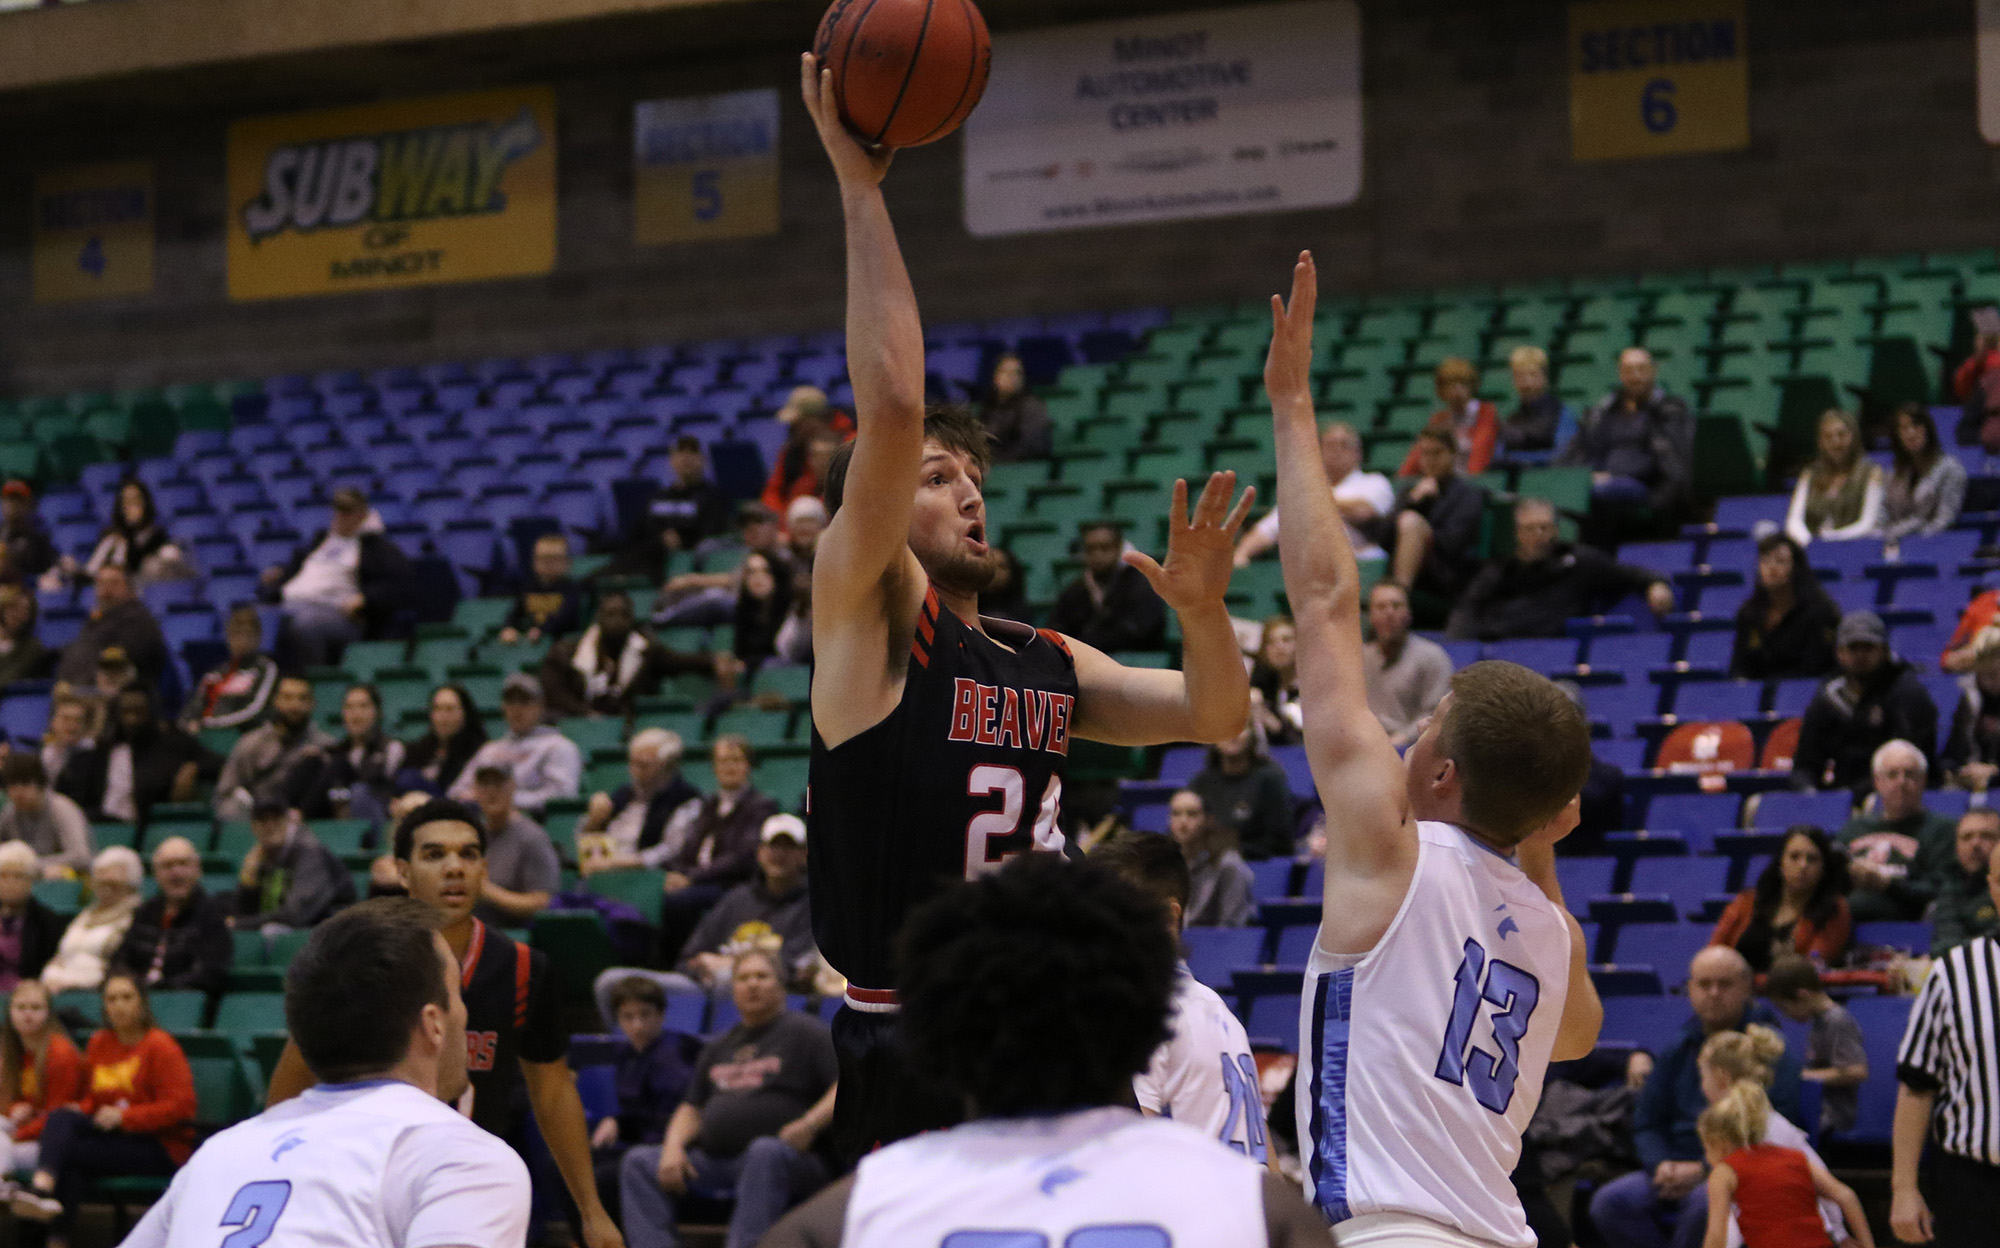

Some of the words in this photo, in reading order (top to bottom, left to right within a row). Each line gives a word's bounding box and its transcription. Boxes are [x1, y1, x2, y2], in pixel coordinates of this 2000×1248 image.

[1580, 20, 1736, 74] SECTION
[1641, 78, 1677, 134] 6
[243, 106, 540, 244] SUBWAY
[693, 170, 723, 221] 5
[1434, 936, 1540, 1115] 13
[1219, 1052, 1269, 1167] 20
